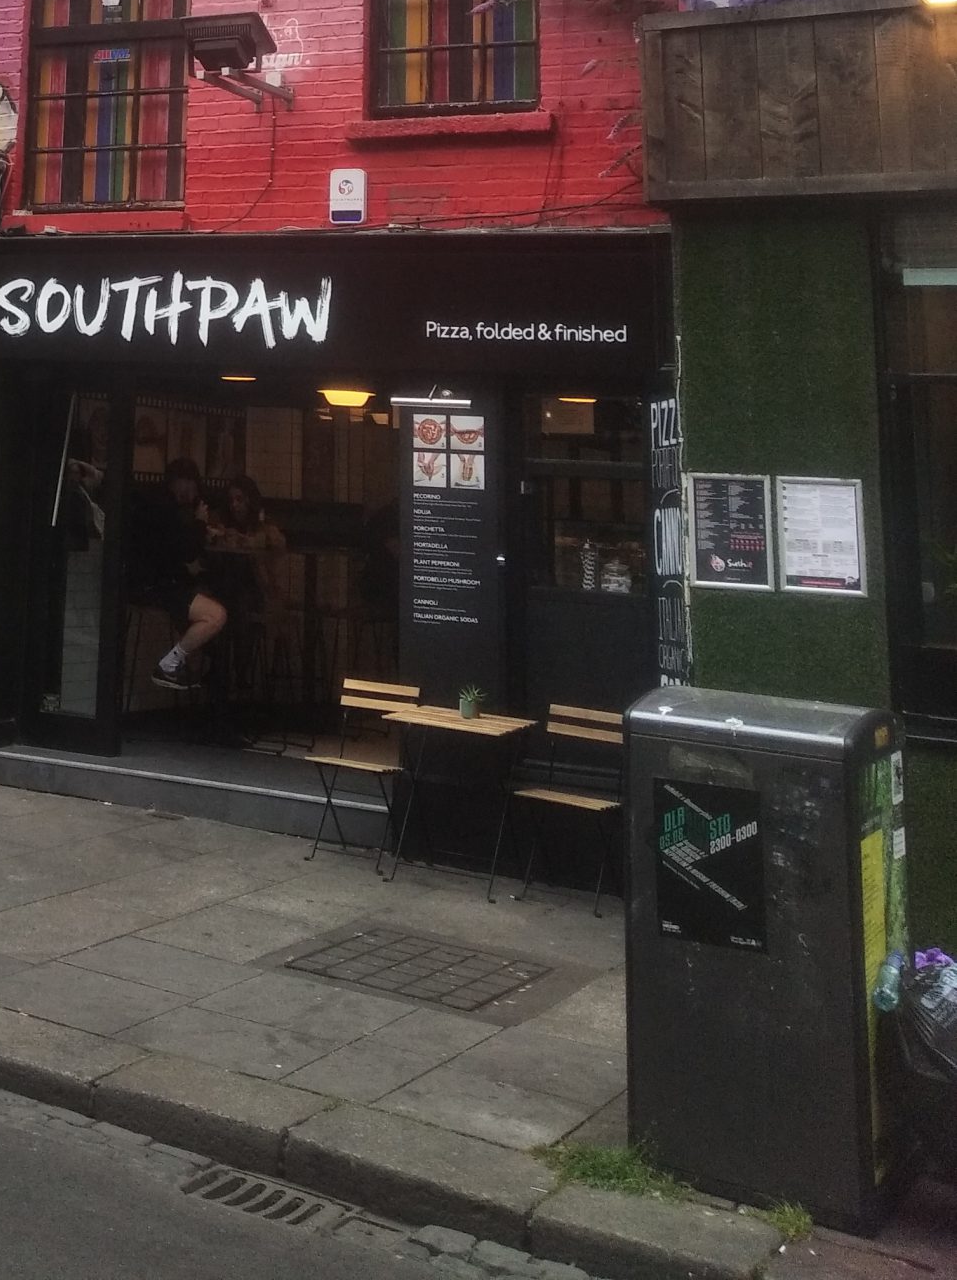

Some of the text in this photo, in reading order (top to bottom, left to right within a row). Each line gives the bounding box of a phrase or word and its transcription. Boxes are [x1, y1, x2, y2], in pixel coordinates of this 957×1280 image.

[426, 321, 627, 343] Pizza, folded & finished
[413, 612, 433, 620] ITALIAN
